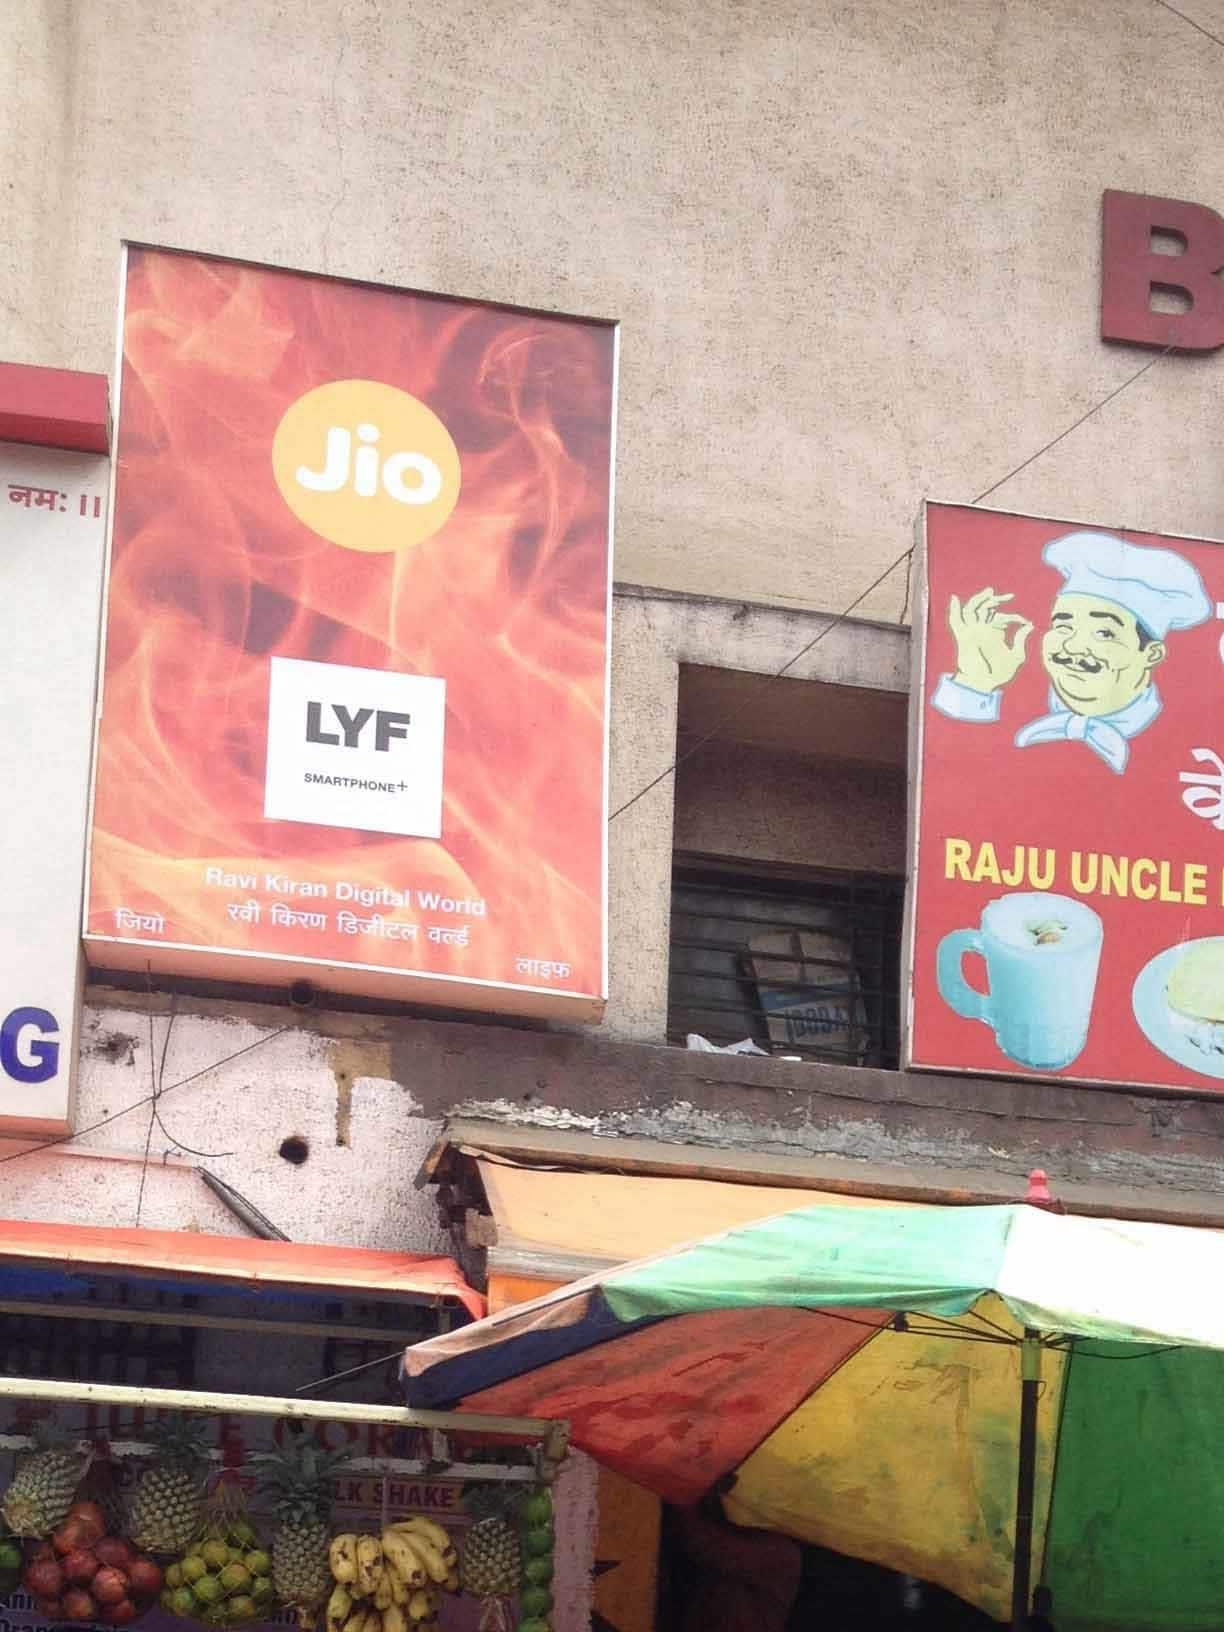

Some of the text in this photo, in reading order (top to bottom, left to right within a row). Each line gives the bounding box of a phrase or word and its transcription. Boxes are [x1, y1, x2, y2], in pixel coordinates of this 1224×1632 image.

[296, 423, 442, 506] Jio
[306, 701, 410, 752] LYF
[205, 866, 486, 917] Ravi Kiran Digital World
[945, 837, 1056, 890] RAJU
[1071, 850, 1208, 905] UNCLE
[270, 901, 326, 932] किरण
[0, 1006, 60, 1084] G
